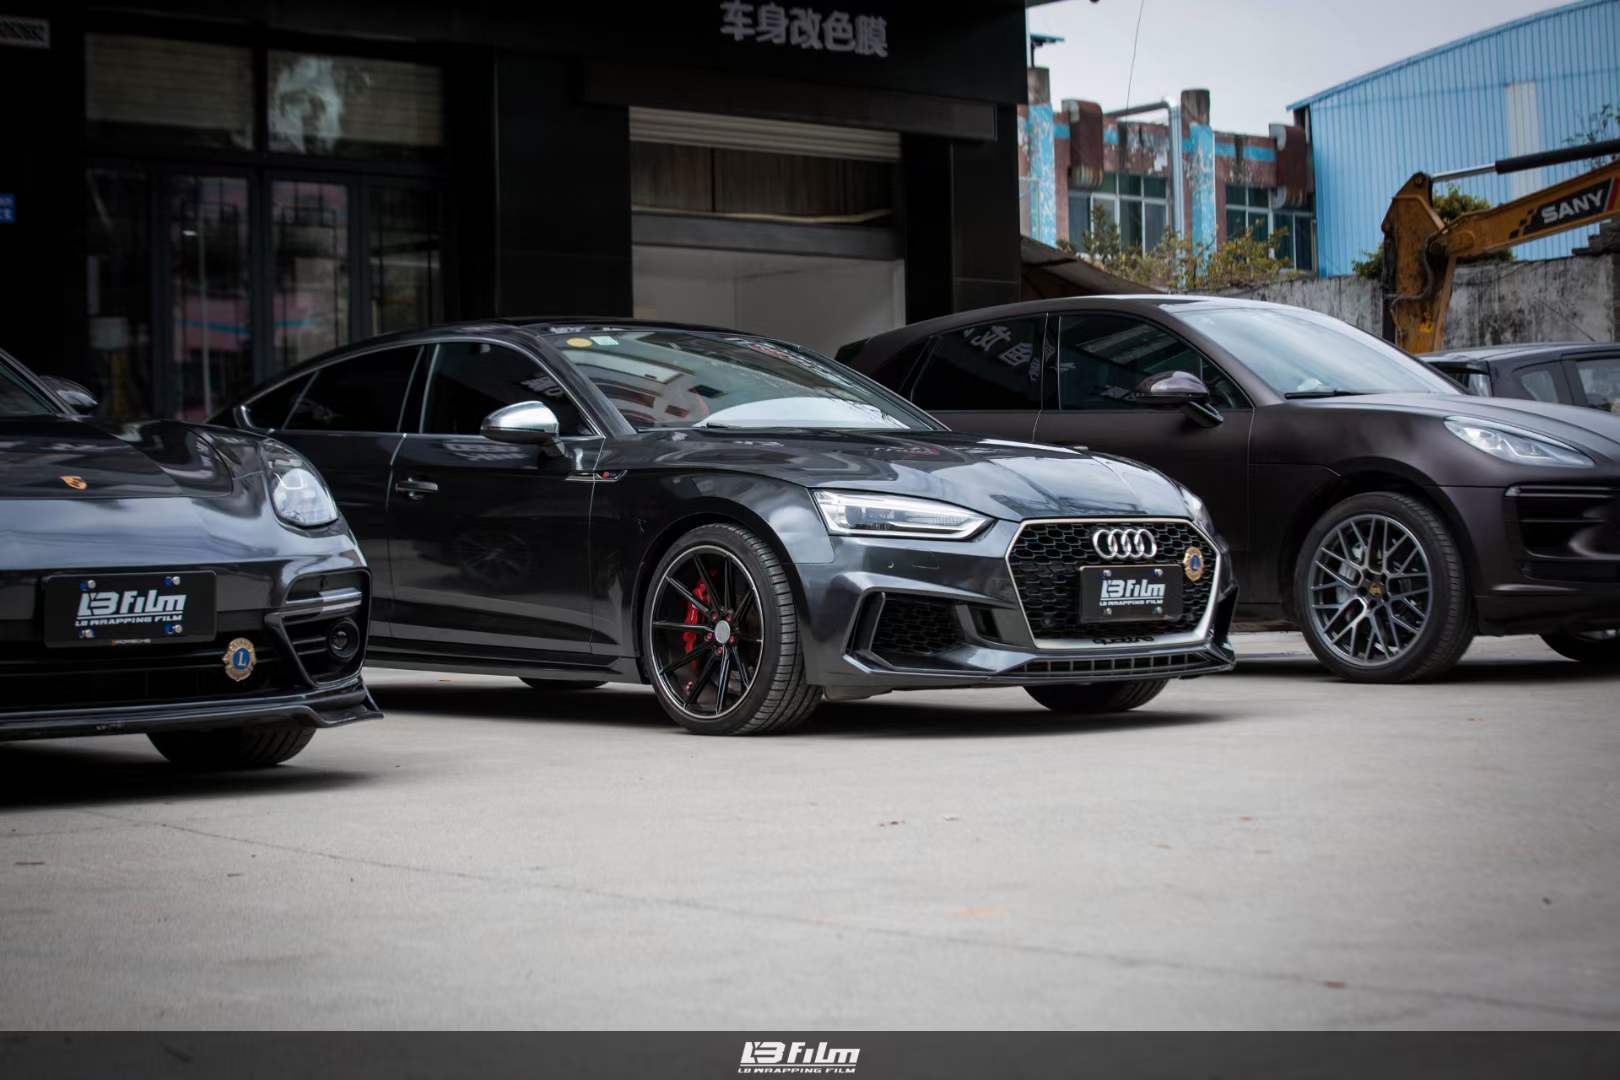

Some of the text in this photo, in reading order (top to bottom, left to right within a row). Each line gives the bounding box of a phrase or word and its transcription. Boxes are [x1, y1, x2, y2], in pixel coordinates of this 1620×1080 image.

[720, 0, 888, 57] 车身改色膜
[1541, 190, 1603, 223] SANY
[90, 617, 152, 626] WRAPPING
[154, 614, 183, 622] FILM
